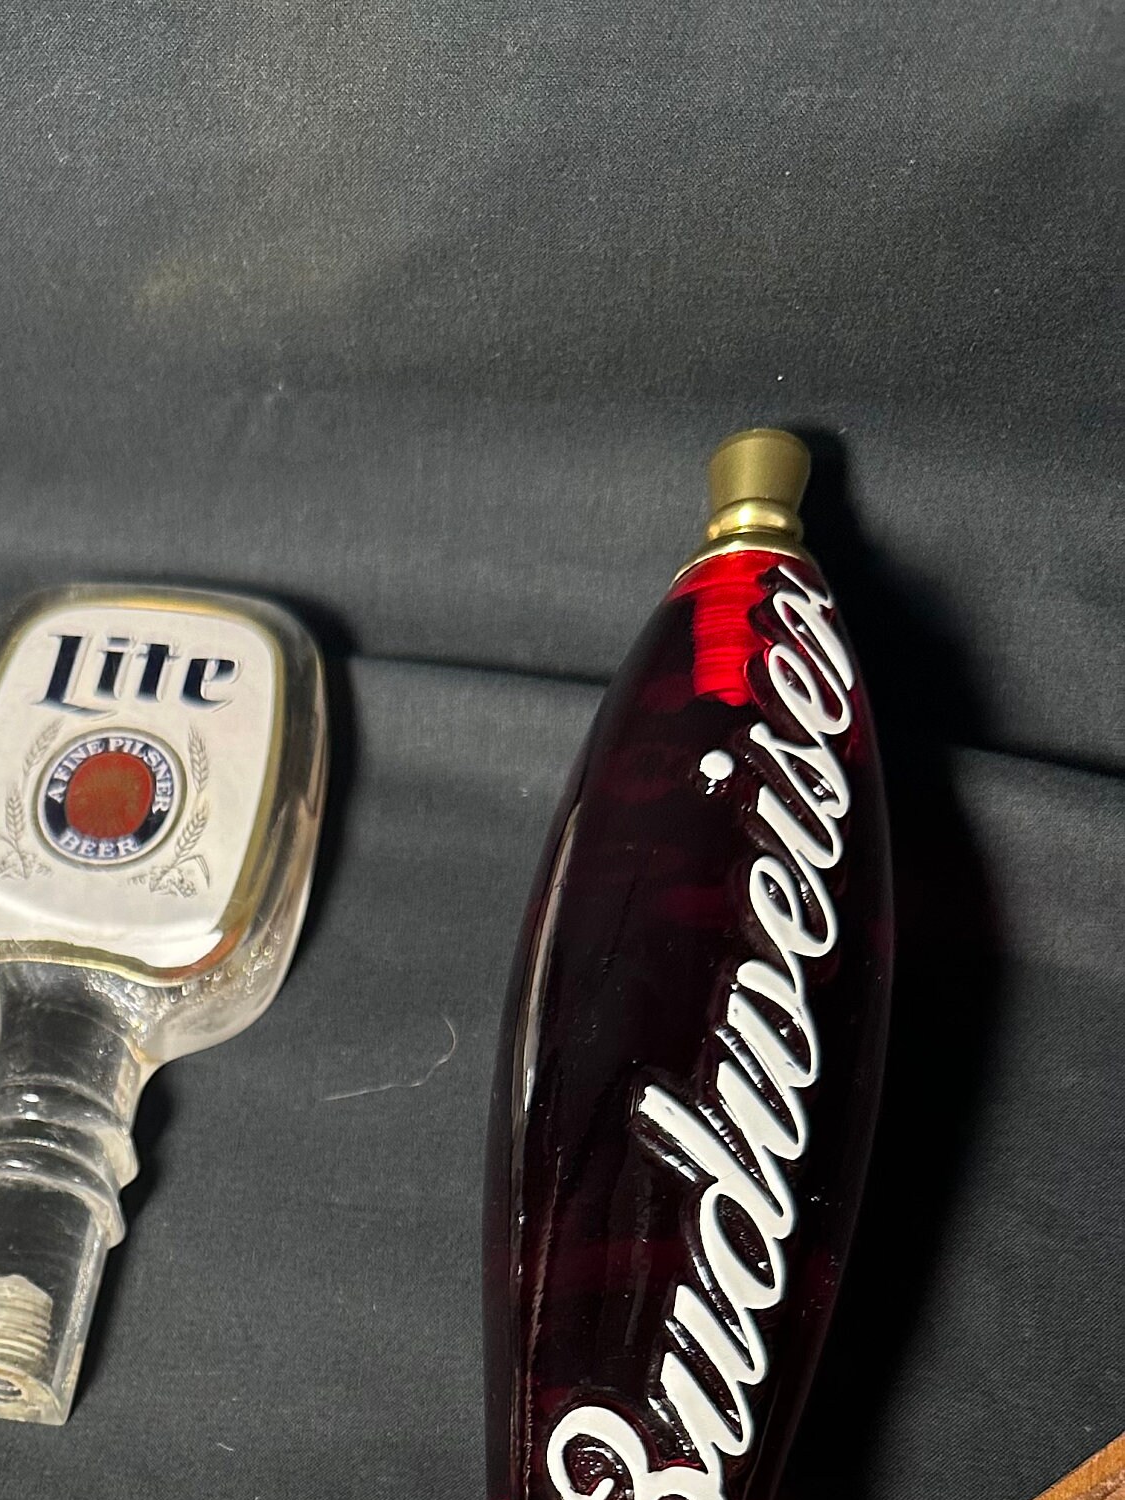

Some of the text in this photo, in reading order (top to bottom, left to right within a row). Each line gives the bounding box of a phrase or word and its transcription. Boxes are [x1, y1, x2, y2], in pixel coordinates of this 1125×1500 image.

[32, 634, 241, 720] Lite
[48, 738, 172, 815] A FINE PILSNER
[58, 828, 139, 858] BEER
